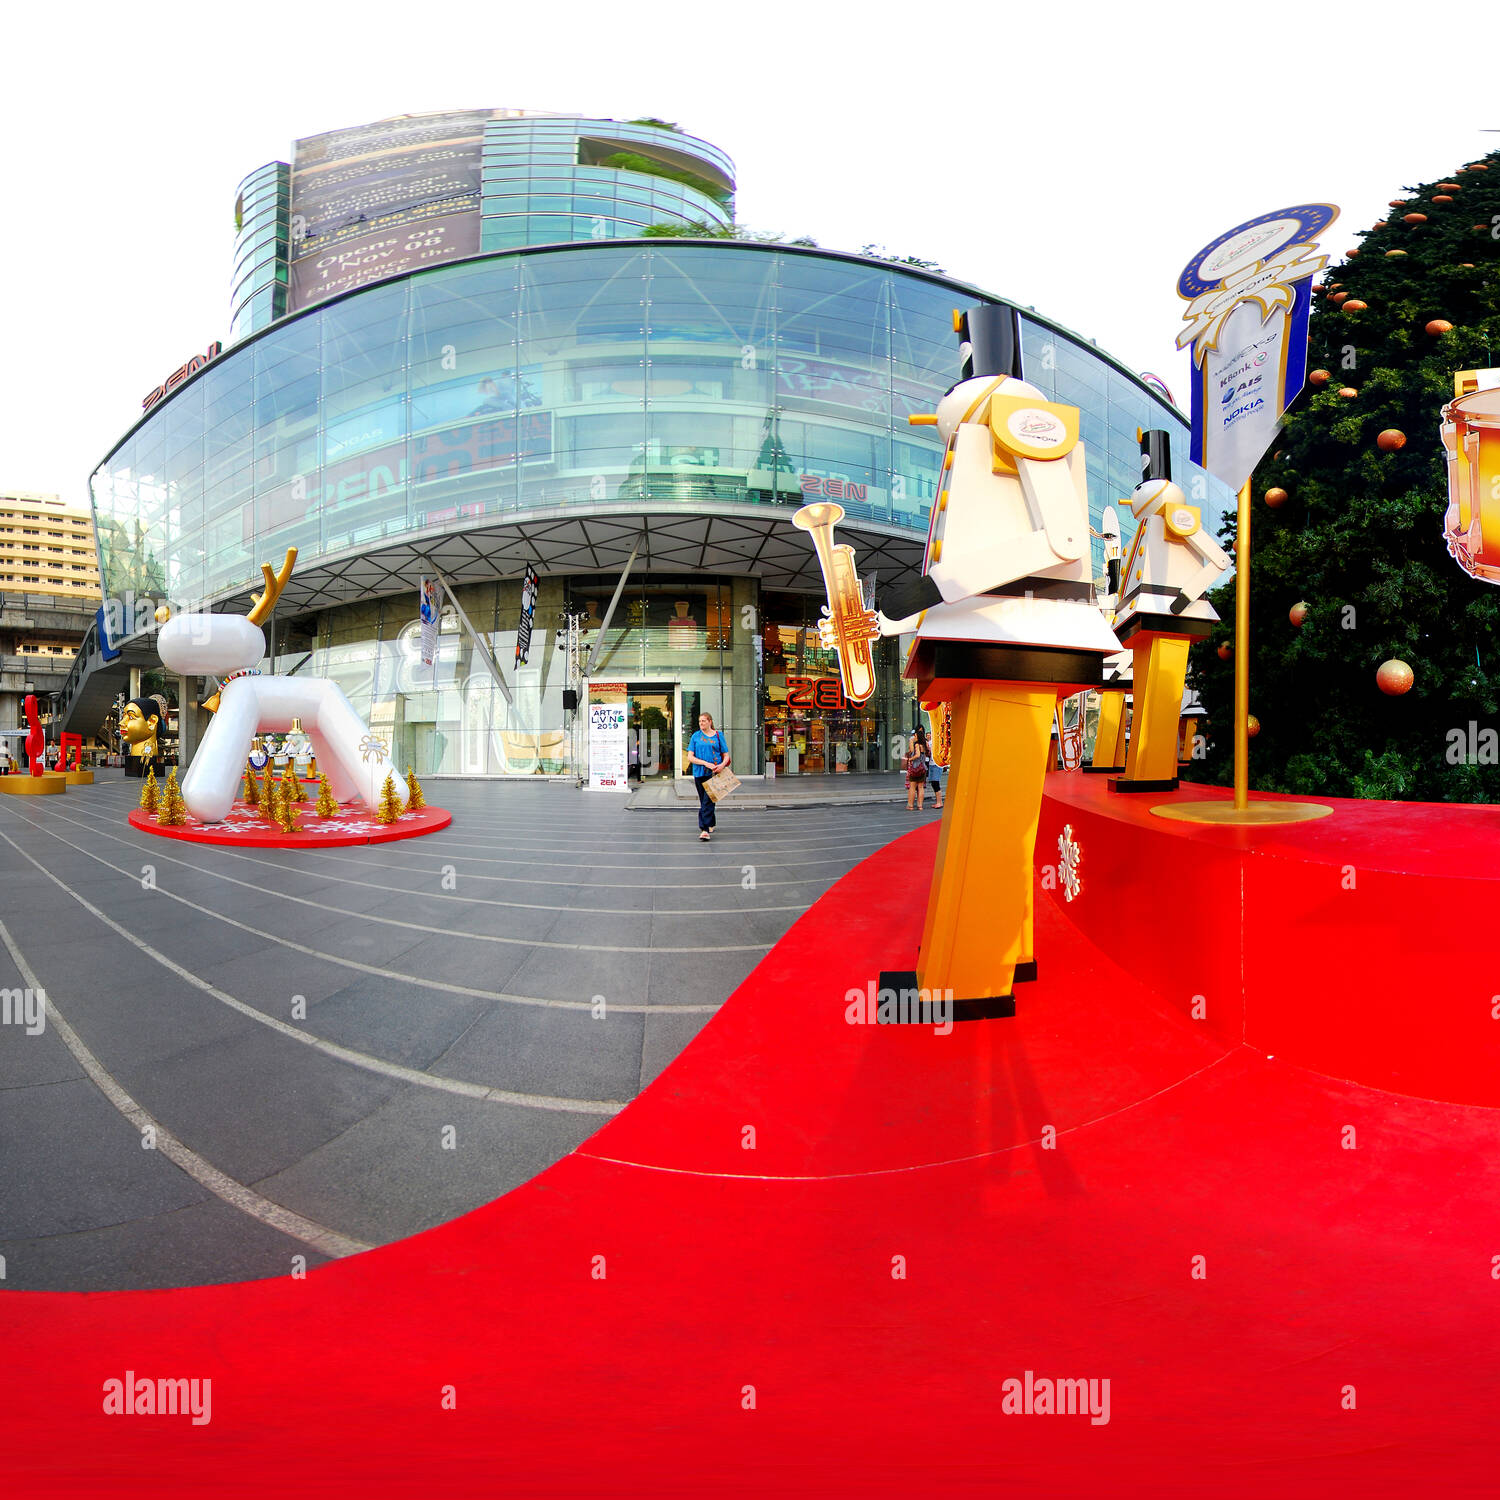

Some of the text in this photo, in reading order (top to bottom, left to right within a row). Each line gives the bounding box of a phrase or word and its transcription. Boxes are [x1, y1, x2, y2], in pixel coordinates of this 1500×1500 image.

[316, 227, 446, 268] Opens on
[321, 236, 442, 279] 1 Nov 08
[306, 246, 456, 298] Experience the
[1236, 374, 1263, 393] AIS
[1223, 398, 1264, 425] NOKIA
[799, 474, 868, 502] ZEN
